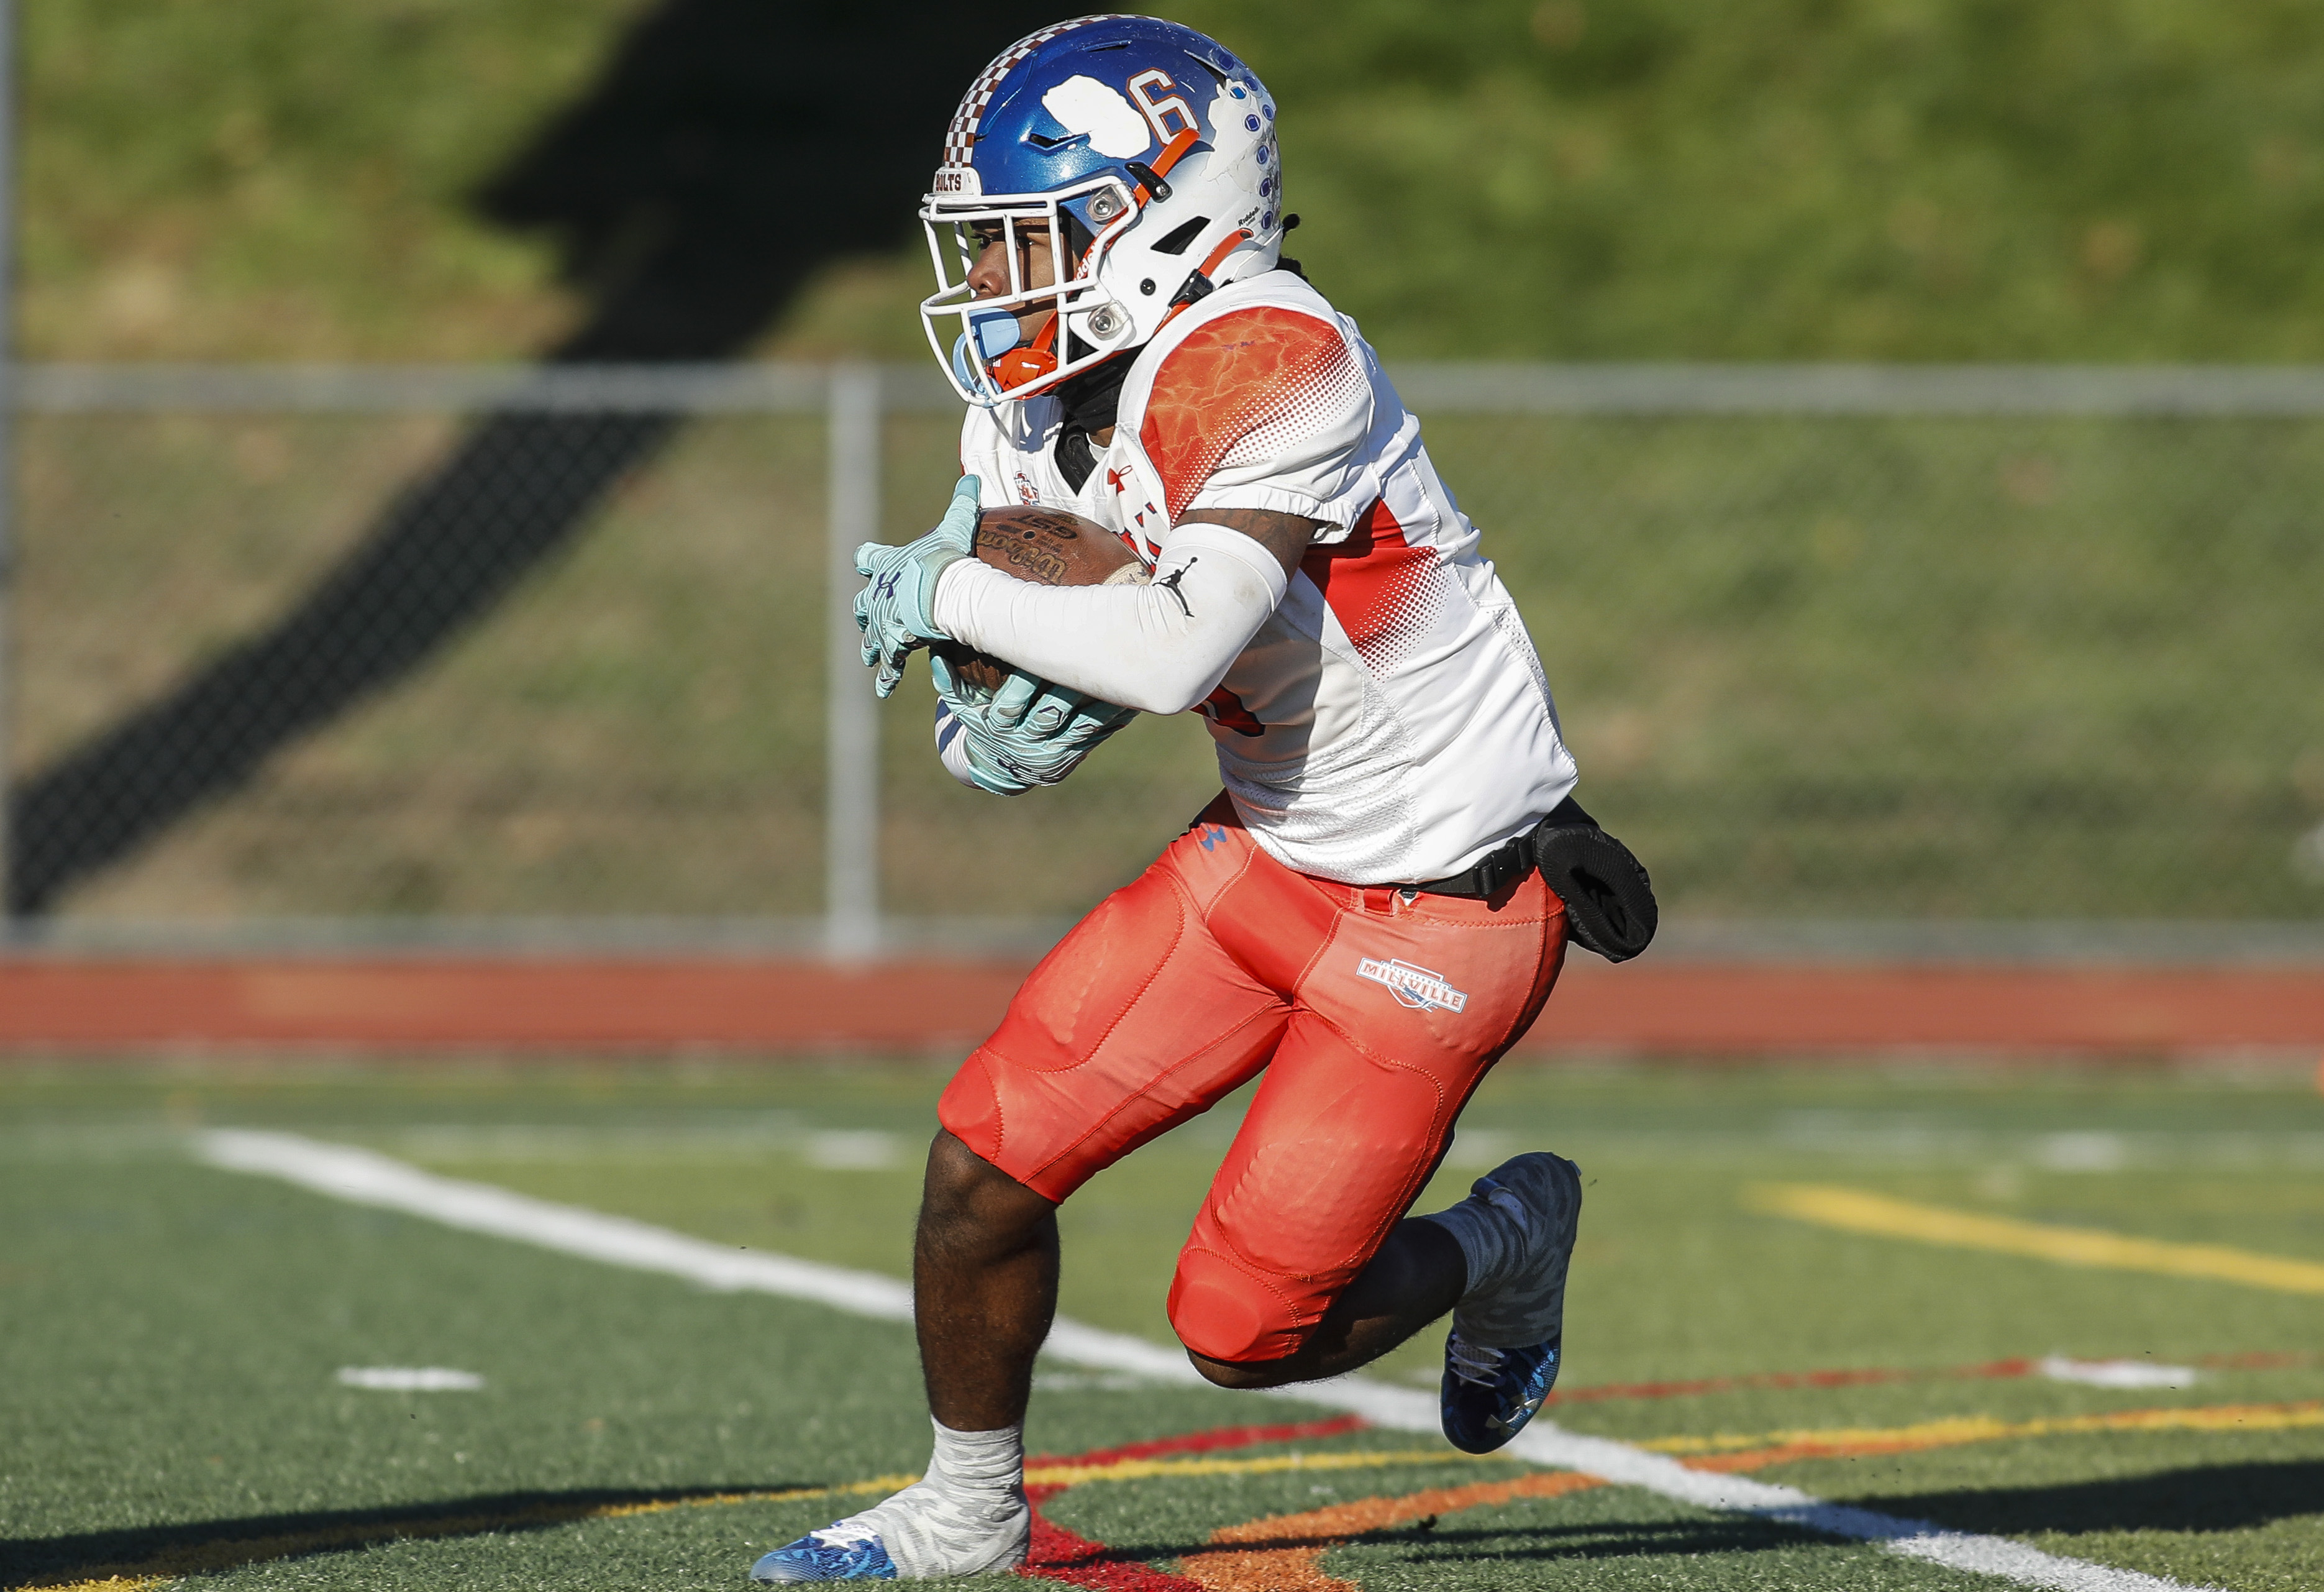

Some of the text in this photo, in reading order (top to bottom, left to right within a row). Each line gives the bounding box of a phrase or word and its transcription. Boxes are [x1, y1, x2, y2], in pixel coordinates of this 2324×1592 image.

[1126, 67, 1201, 149] 6
[977, 530, 1067, 585] Wilson
[1362, 963, 1464, 1008] MILLVILLE
